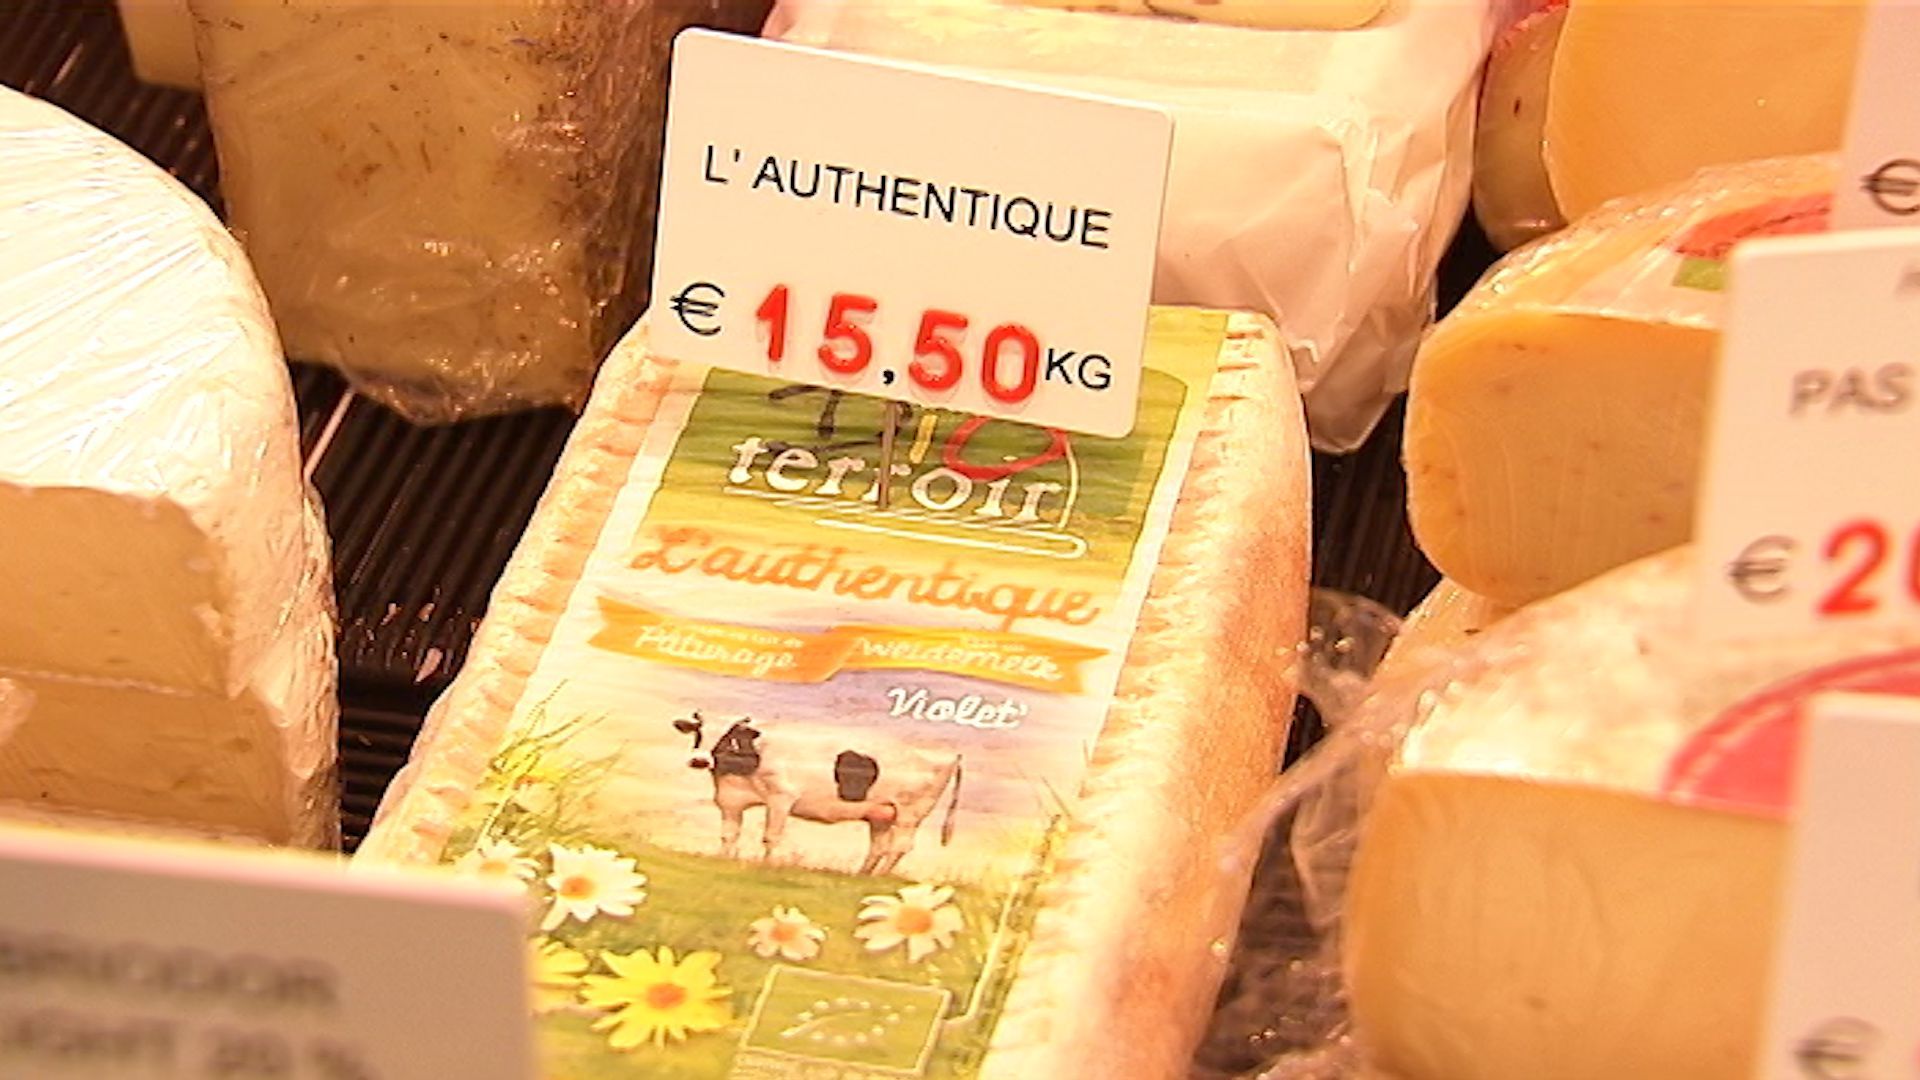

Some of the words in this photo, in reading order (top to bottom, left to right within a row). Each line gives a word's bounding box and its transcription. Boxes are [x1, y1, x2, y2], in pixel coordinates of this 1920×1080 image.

[752, 156, 1113, 250] AUTHENTIQUE
[669, 281, 726, 338] €
[1728, 535, 1797, 604] €
[1818, 520, 1920, 616] 2
